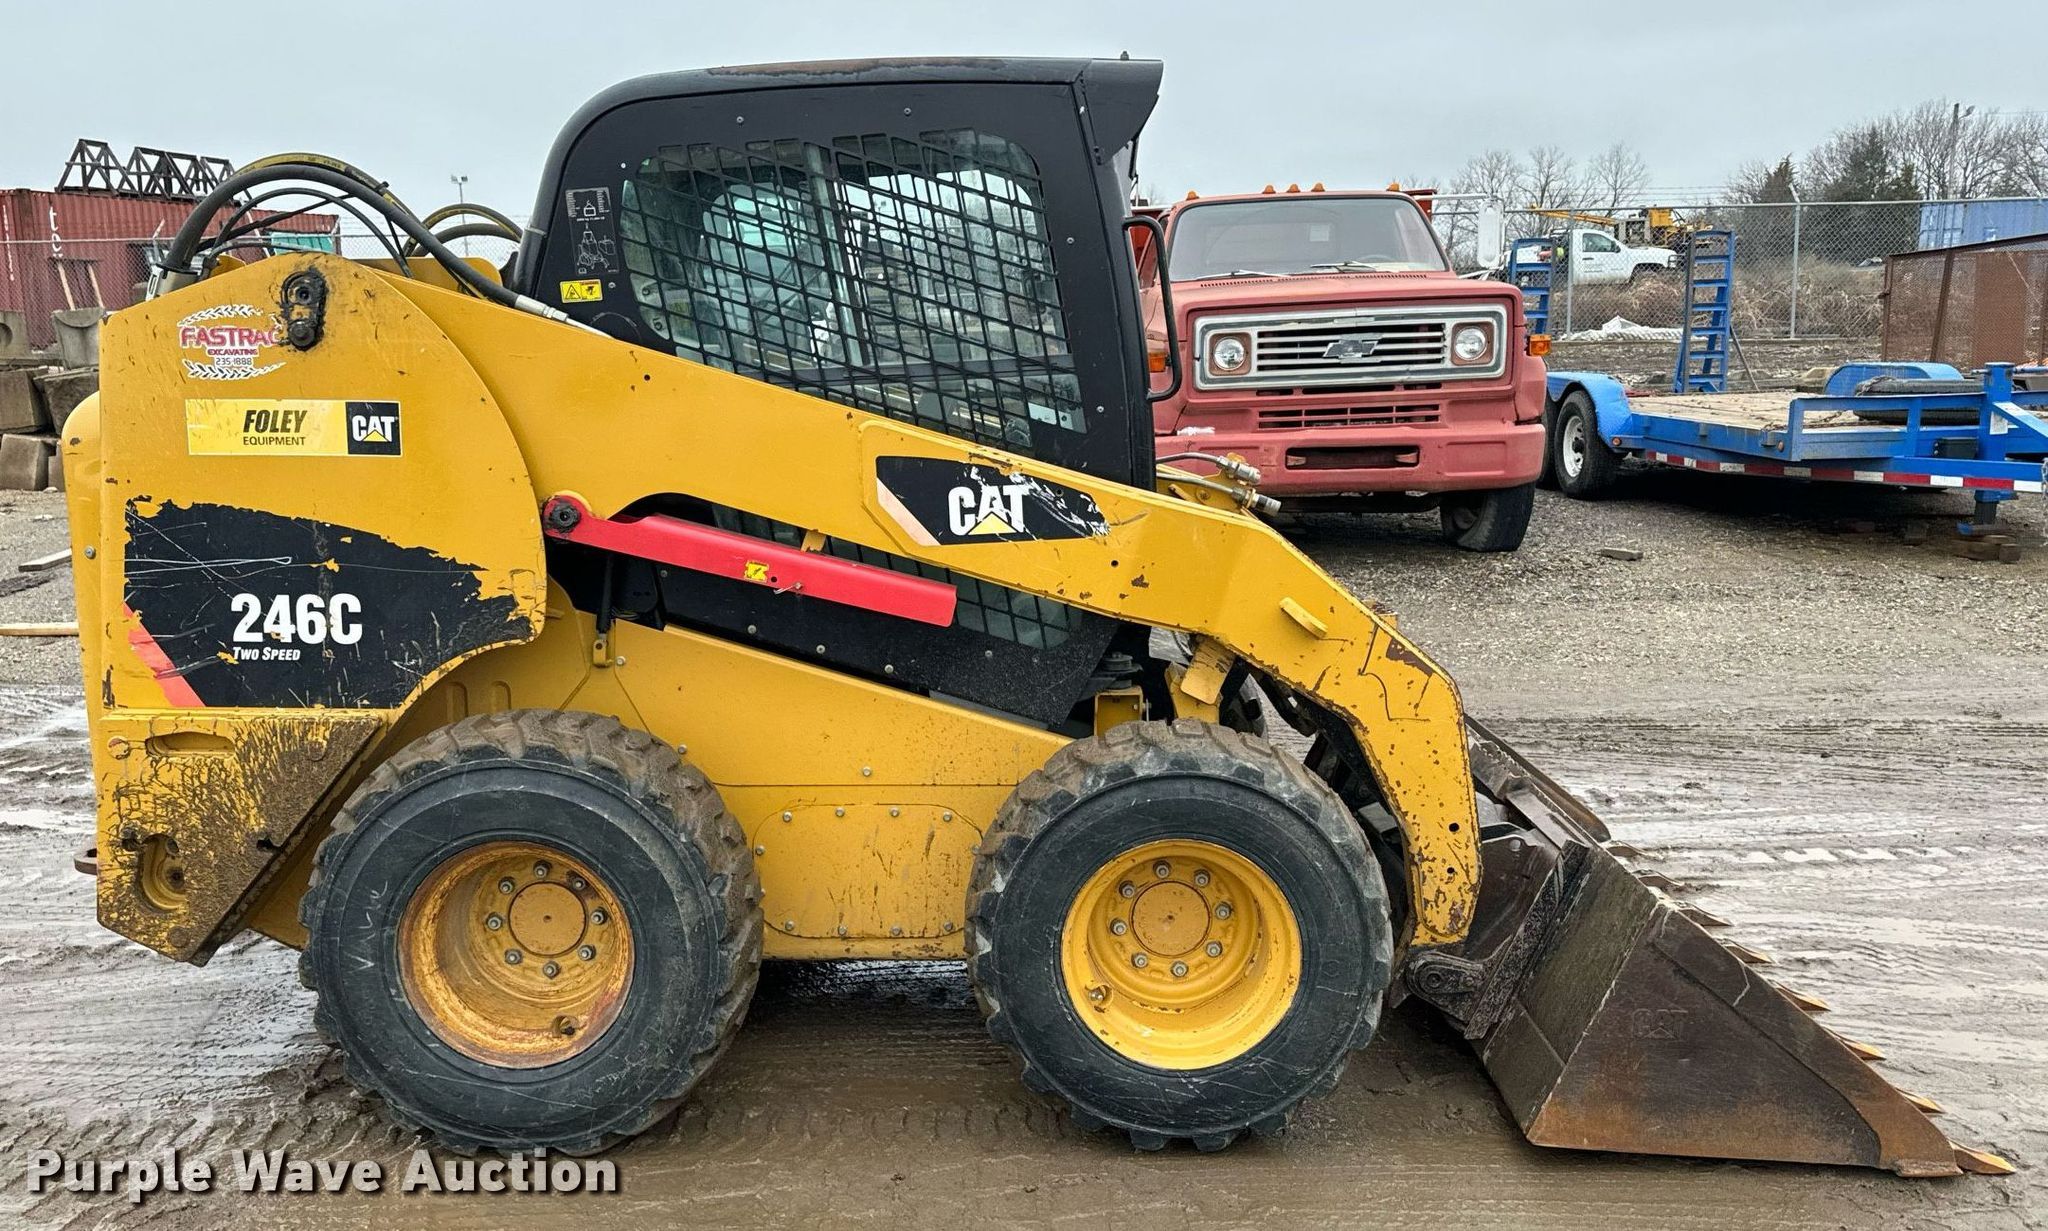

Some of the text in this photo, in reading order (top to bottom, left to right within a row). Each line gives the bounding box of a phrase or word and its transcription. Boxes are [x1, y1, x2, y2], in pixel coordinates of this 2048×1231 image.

[207, 348, 258, 356] EXCAVATING
[243, 409, 307, 433] FOLEY
[351, 415, 396, 442] CAT
[243, 436, 306, 446] EQUIPMENT
[948, 484, 1029, 536] CAT
[230, 593, 363, 645] 246C
